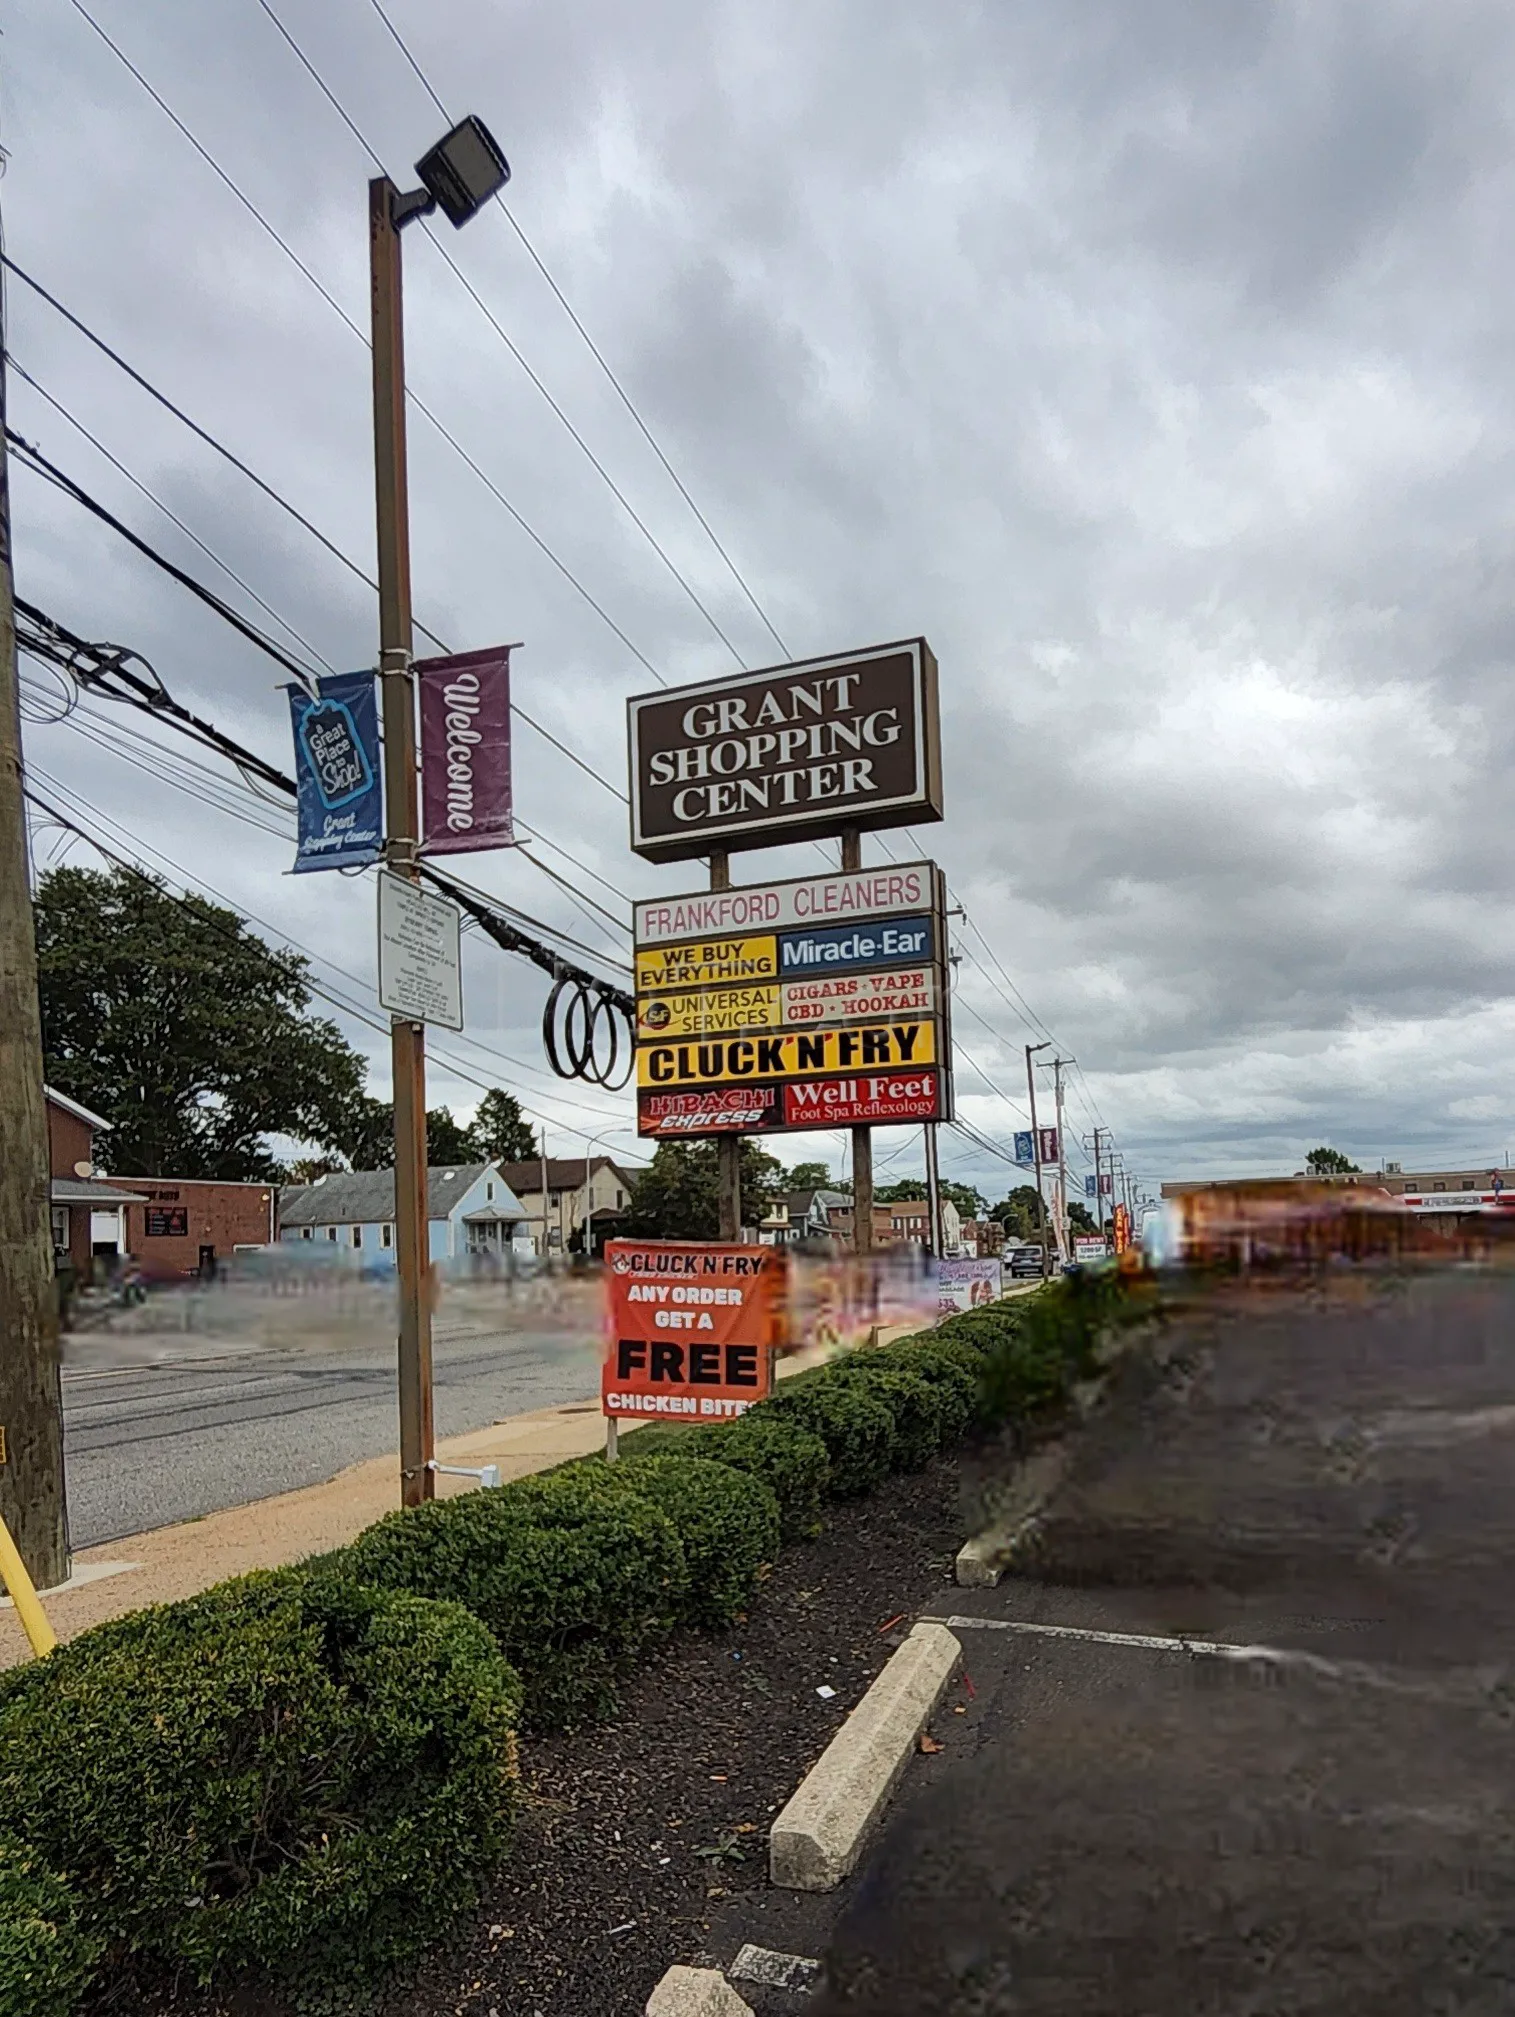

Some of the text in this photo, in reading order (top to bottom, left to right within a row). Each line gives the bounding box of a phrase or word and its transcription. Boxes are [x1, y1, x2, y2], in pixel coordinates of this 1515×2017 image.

[682, 673, 860, 739] GRANT
[309, 723, 346, 751] Great
[649, 708, 902, 787] SHOPPING
[315, 739, 350, 767] Place
[443, 673, 482, 833] Welcome
[322, 750, 362, 794] Shop!
[672, 758, 878, 822] CENTER
[645, 872, 921, 937] FRANKFORD CLEANERS
[662, 942, 745, 967] WE BUY
[641, 956, 772, 986] EVERYTHING
[787, 973, 924, 1001] CIGARS VAPE
[672, 988, 777, 1015] UNIVERSAL
[787, 992, 929, 1020] CBD HOOKAH
[682, 1008, 769, 1032] SERVICES
[650, 1087, 775, 1116] HIBACHI
[789, 1075, 935, 1105] Well Feet
[791, 1099, 936, 1121] Foot Spa Reflexology
[628, 1285, 743, 1306] ANY ORDER
[655, 1311, 714, 1330] GET A
[617, 1339, 758, 1386] FREE
[607, 1393, 697, 1414] CHICKEN
